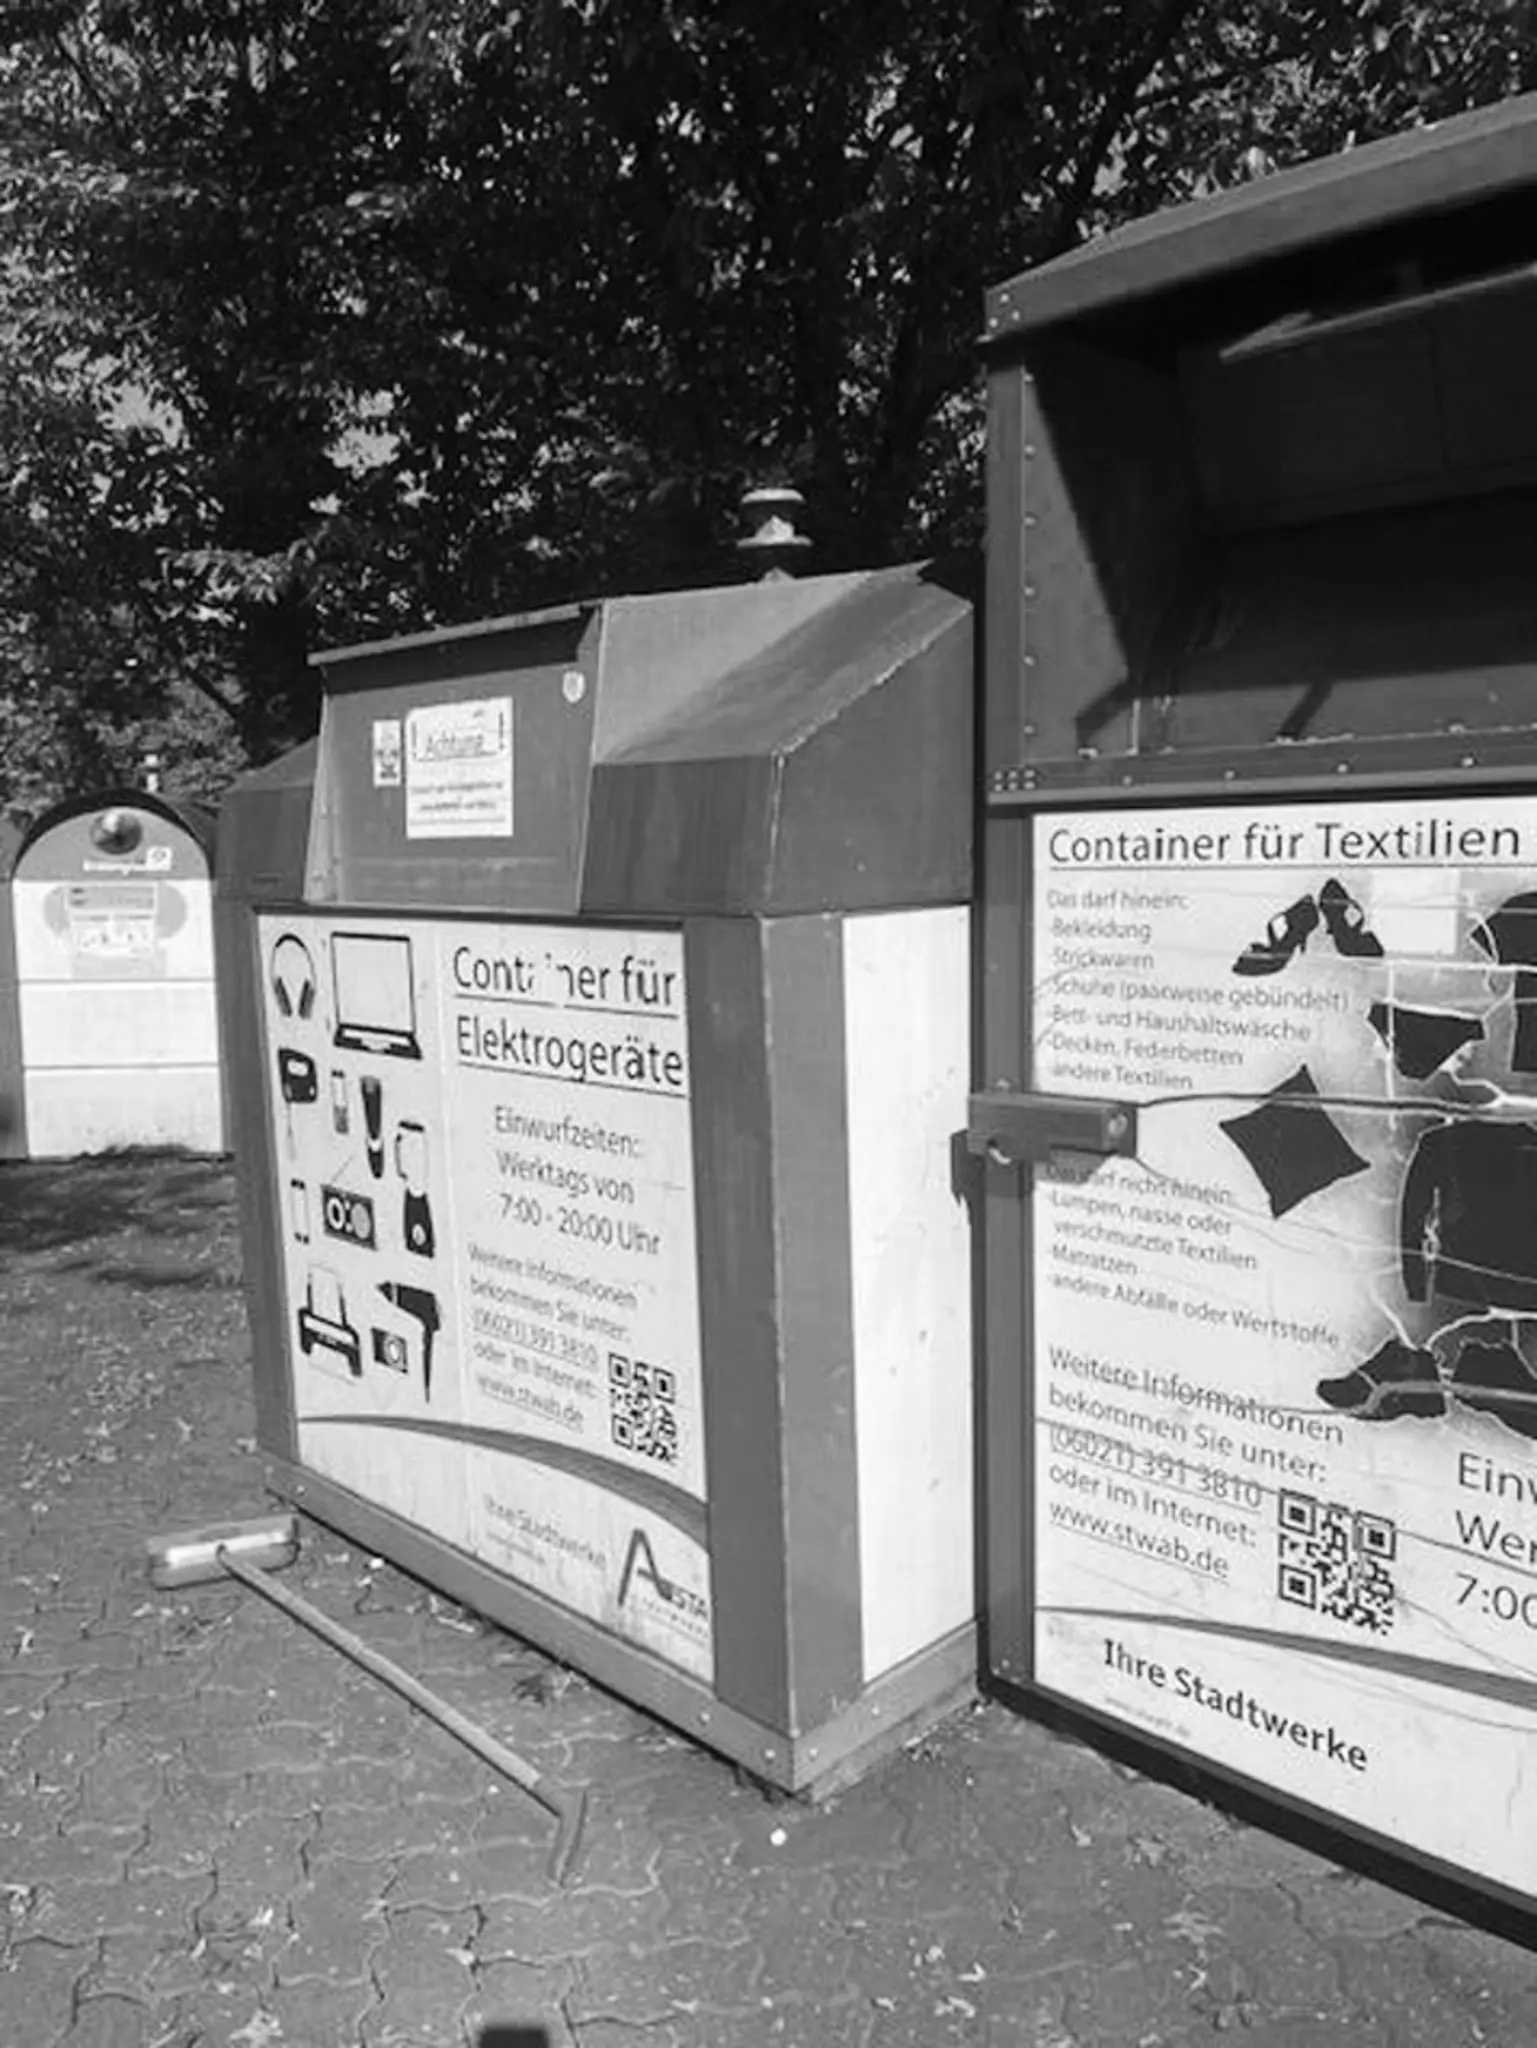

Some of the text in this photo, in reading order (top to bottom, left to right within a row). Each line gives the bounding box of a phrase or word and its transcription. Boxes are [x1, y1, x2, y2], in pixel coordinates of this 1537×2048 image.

[1049, 819, 1520, 862] Container für Textilien
[622, 954, 676, 1006] für
[457, 1015, 684, 1086] Elektrogeräte
[595, 1177, 636, 1205] von
[1187, 1212, 1231, 1236] oder
[1049, 1346, 1344, 1445] Weitere Informationen
[1049, 1381, 1328, 1484] bekommen Sie unter:
[1049, 1463, 1258, 1550] oder im Internet:
[1049, 1500, 1232, 1580] www.stwab.de
[1103, 1637, 1167, 1689] Ihre
[1173, 1666, 1369, 1773] Stadtwerke
